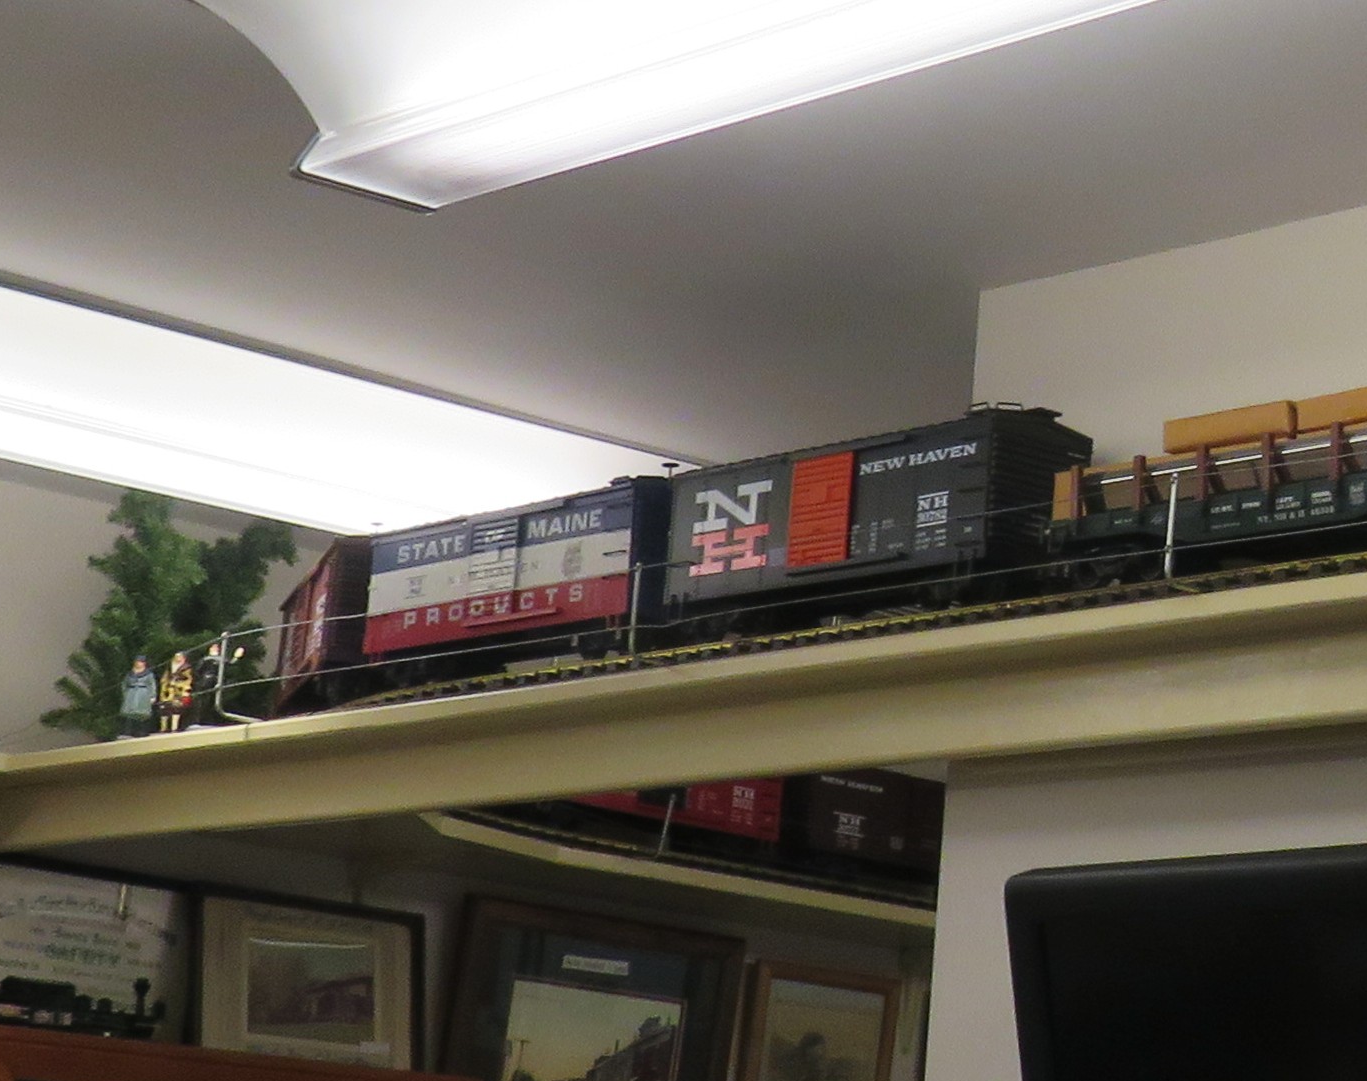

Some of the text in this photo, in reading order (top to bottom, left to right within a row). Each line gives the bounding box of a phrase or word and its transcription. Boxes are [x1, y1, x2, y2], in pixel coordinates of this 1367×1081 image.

[859, 442, 978, 476] NEW HAVEN
[693, 480, 773, 534] N
[396, 534, 466, 564] STATE
[527, 508, 603, 539] MAINE
[688, 523, 770, 578] H
[402, 584, 584, 629] PRODUCTS
